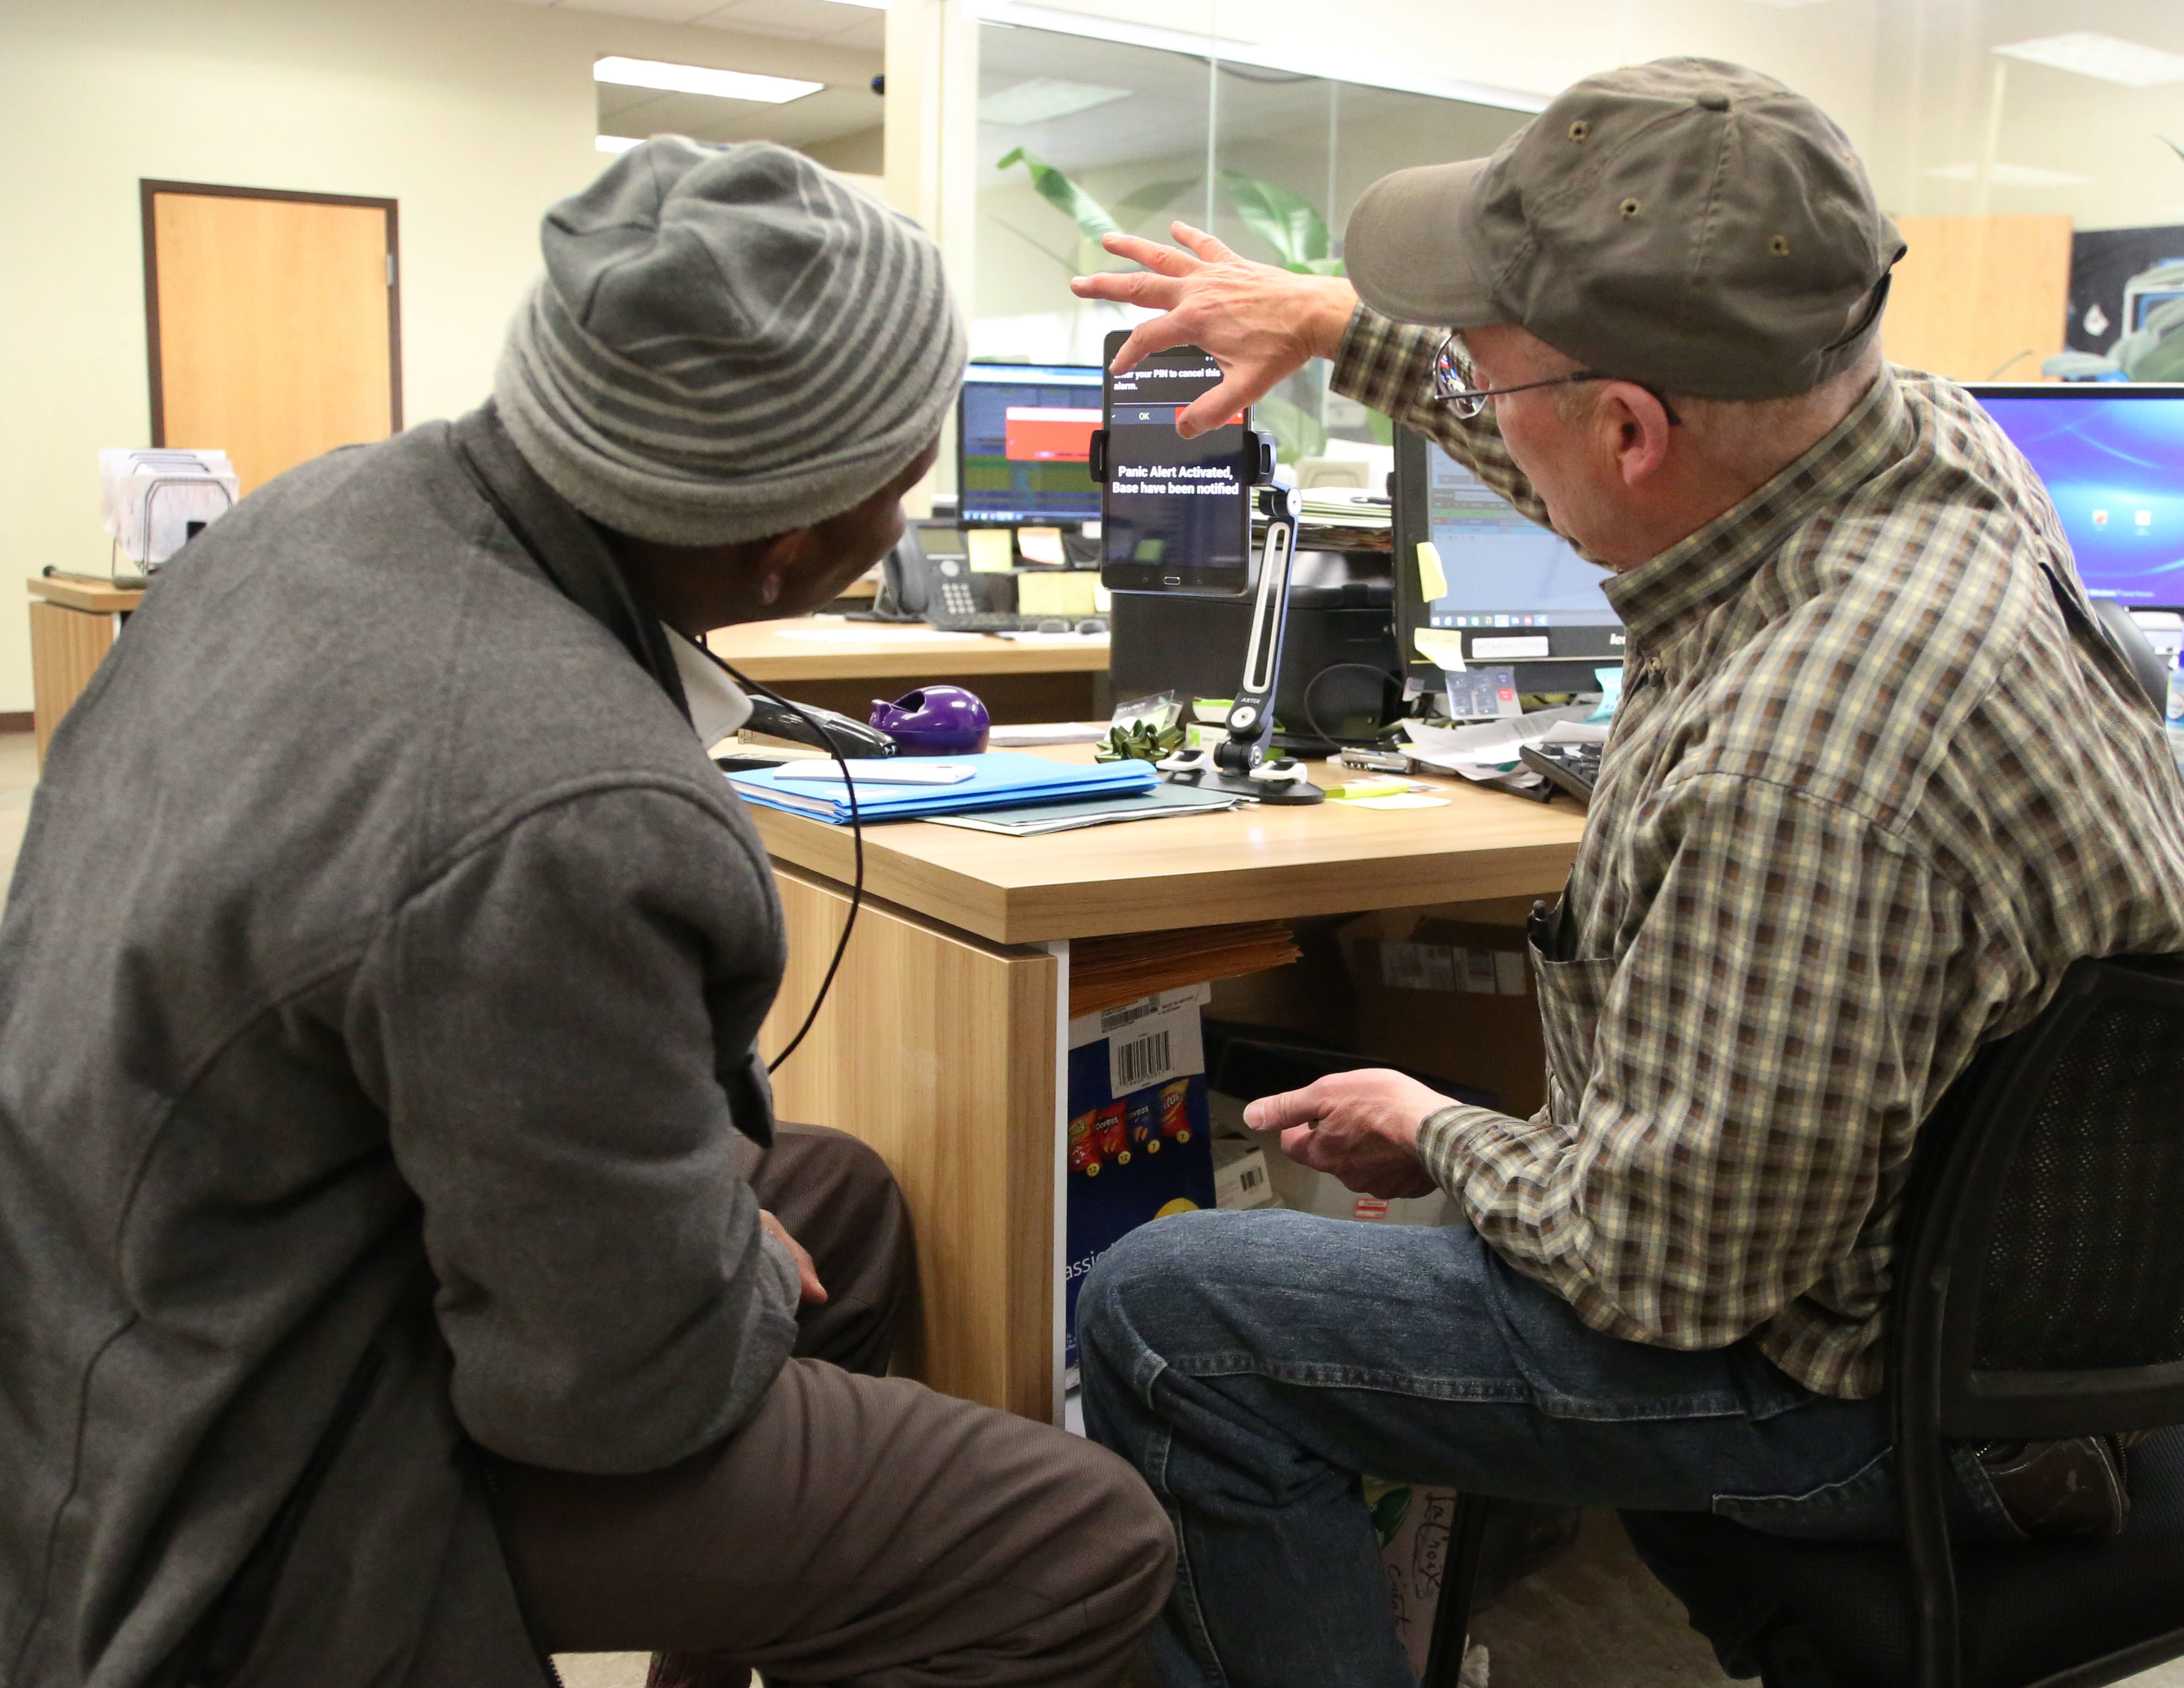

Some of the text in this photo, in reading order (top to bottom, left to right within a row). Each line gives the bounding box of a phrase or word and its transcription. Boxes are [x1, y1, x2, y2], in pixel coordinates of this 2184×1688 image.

[1135, 370, 1153, 380] your
[1153, 369, 1168, 378] PIN
[1169, 370, 1177, 378] to
[1178, 368, 1204, 378] cancel
[1205, 368, 1221, 377] this
[1113, 382, 1138, 390] alarm.
[1139, 412, 1150, 420] OK
[1118, 466, 1233, 480] Panic Alert Activated,
[1112, 481, 1239, 495] Base have been notified
[1096, 1116, 1118, 1131] Doritos
[1119, 1154, 1128, 1162] 12
[1088, 1166, 1097, 1174] 12
